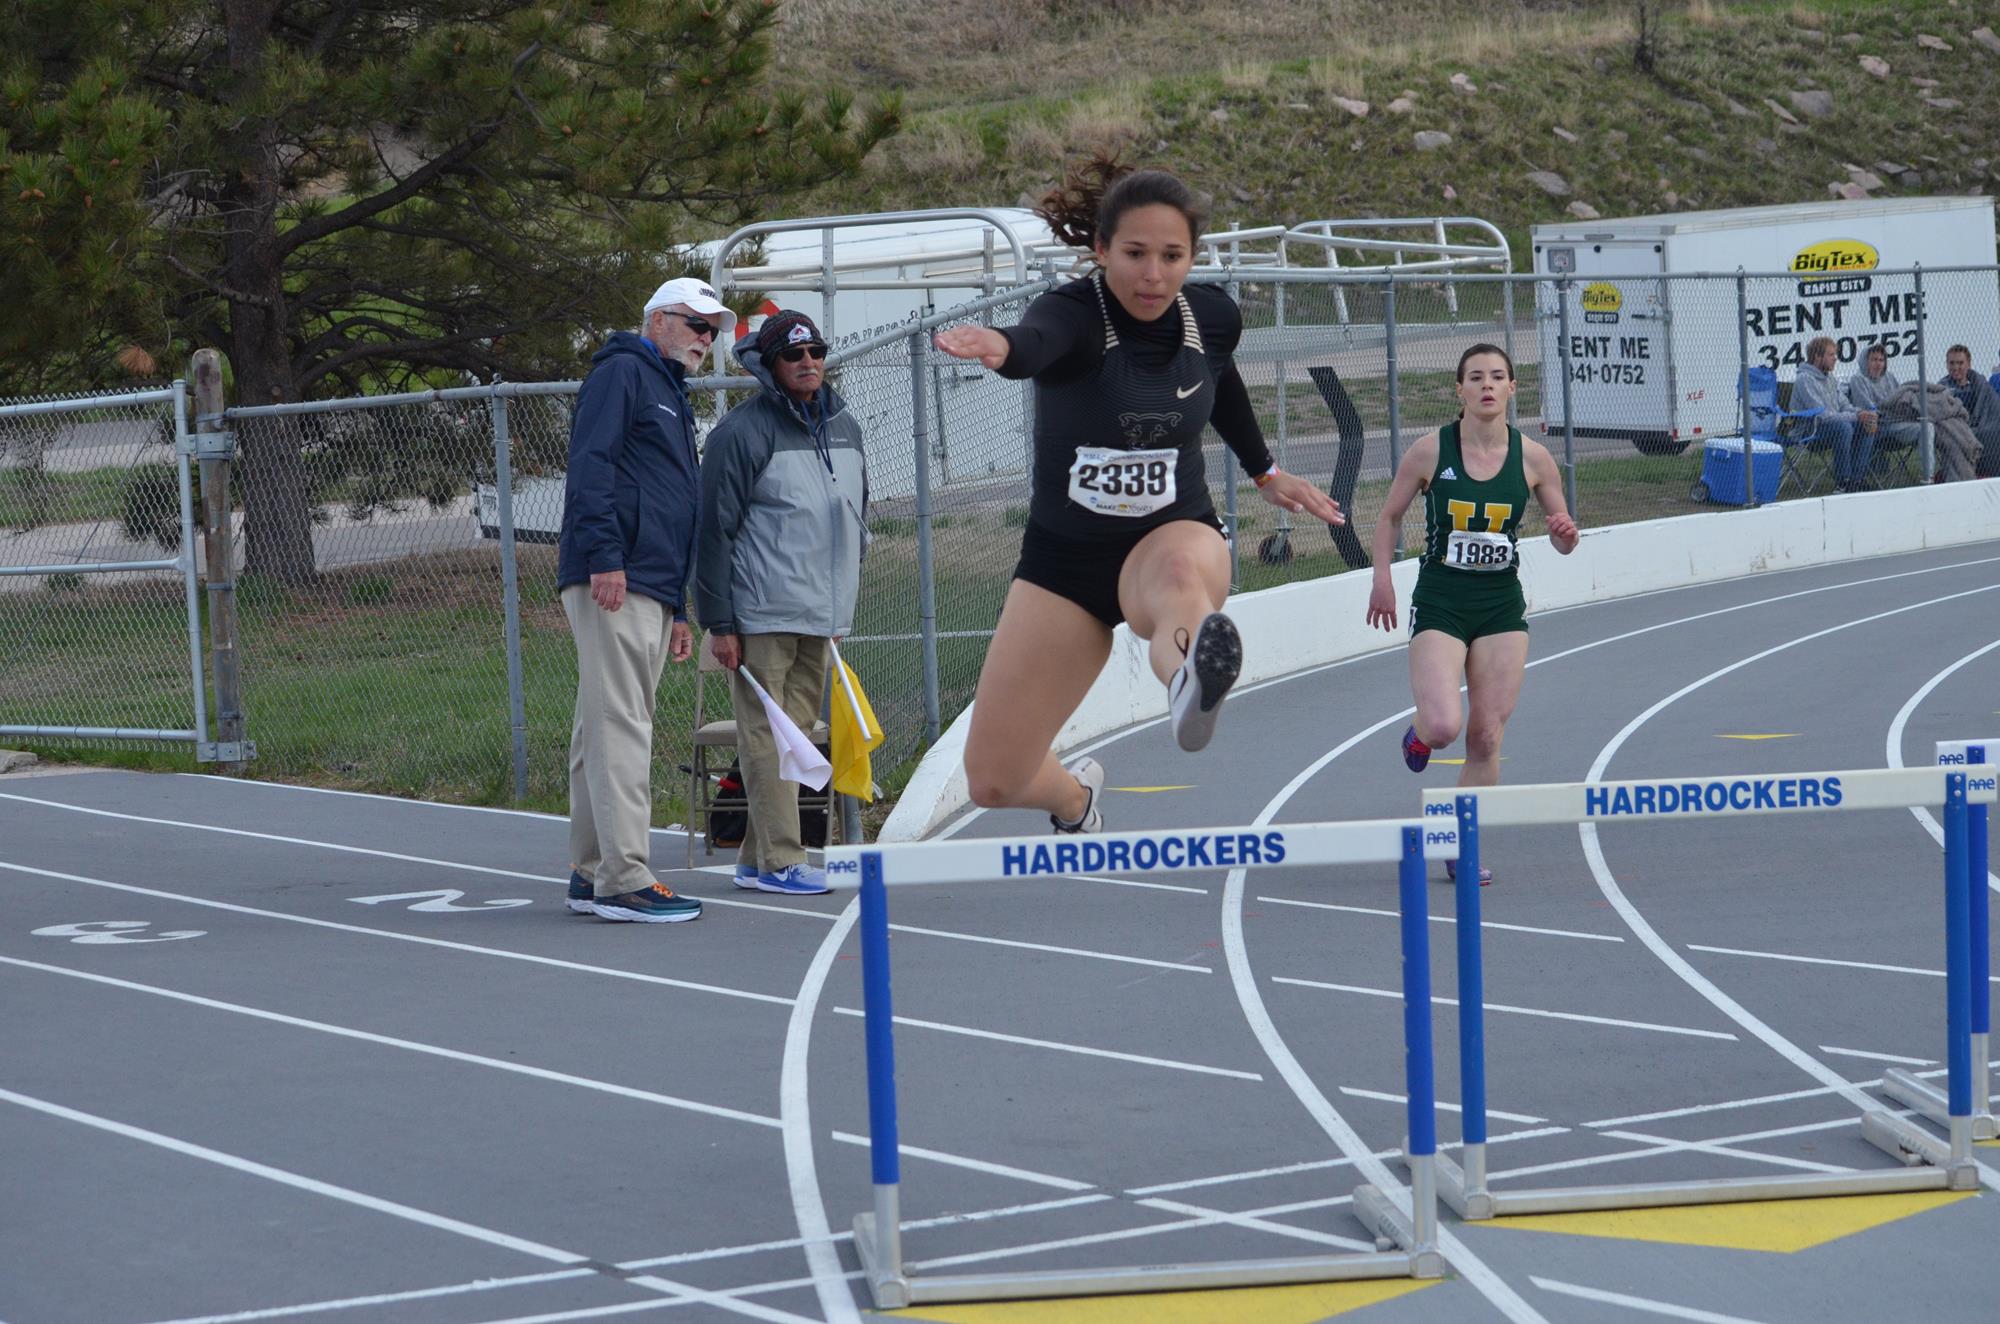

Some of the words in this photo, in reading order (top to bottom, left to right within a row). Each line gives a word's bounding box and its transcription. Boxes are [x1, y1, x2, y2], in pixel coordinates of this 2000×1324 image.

[1804, 282, 1838, 295] RAPID
[1841, 279, 1866, 291] CITY
[1869, 292, 1928, 325] ME
[1620, 337, 1650, 359] ME
[1686, 390, 1705, 401] XLE
[1078, 461, 1168, 497] 2339
[1454, 541, 1508, 565] 1983
[1586, 777, 1842, 816] HARDROCKERS
[1002, 832, 1286, 876] HARDROCKERS
